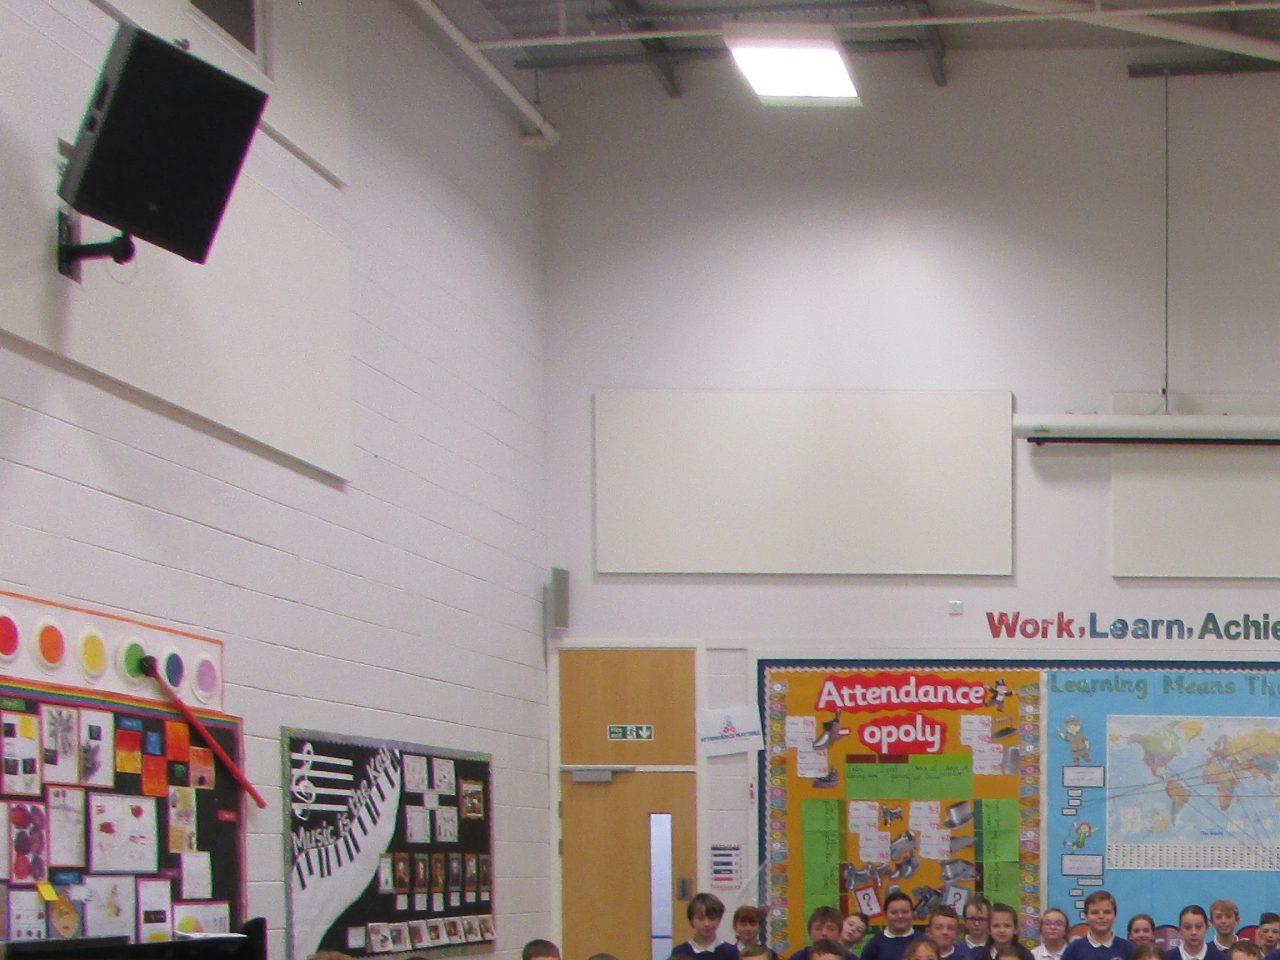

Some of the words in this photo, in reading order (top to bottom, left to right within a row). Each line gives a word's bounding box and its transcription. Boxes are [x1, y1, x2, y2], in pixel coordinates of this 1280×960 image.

[818, 676, 985, 708] Attendance
[1050, 674, 1148, 700] Learning
[1162, 675, 1236, 696] Means
[863, 714, 941, 754] opoly
[291, 821, 336, 857] Music
[337, 812, 351, 837] is
[347, 779, 370, 817] the
[365, 744, 392, 786] Key
